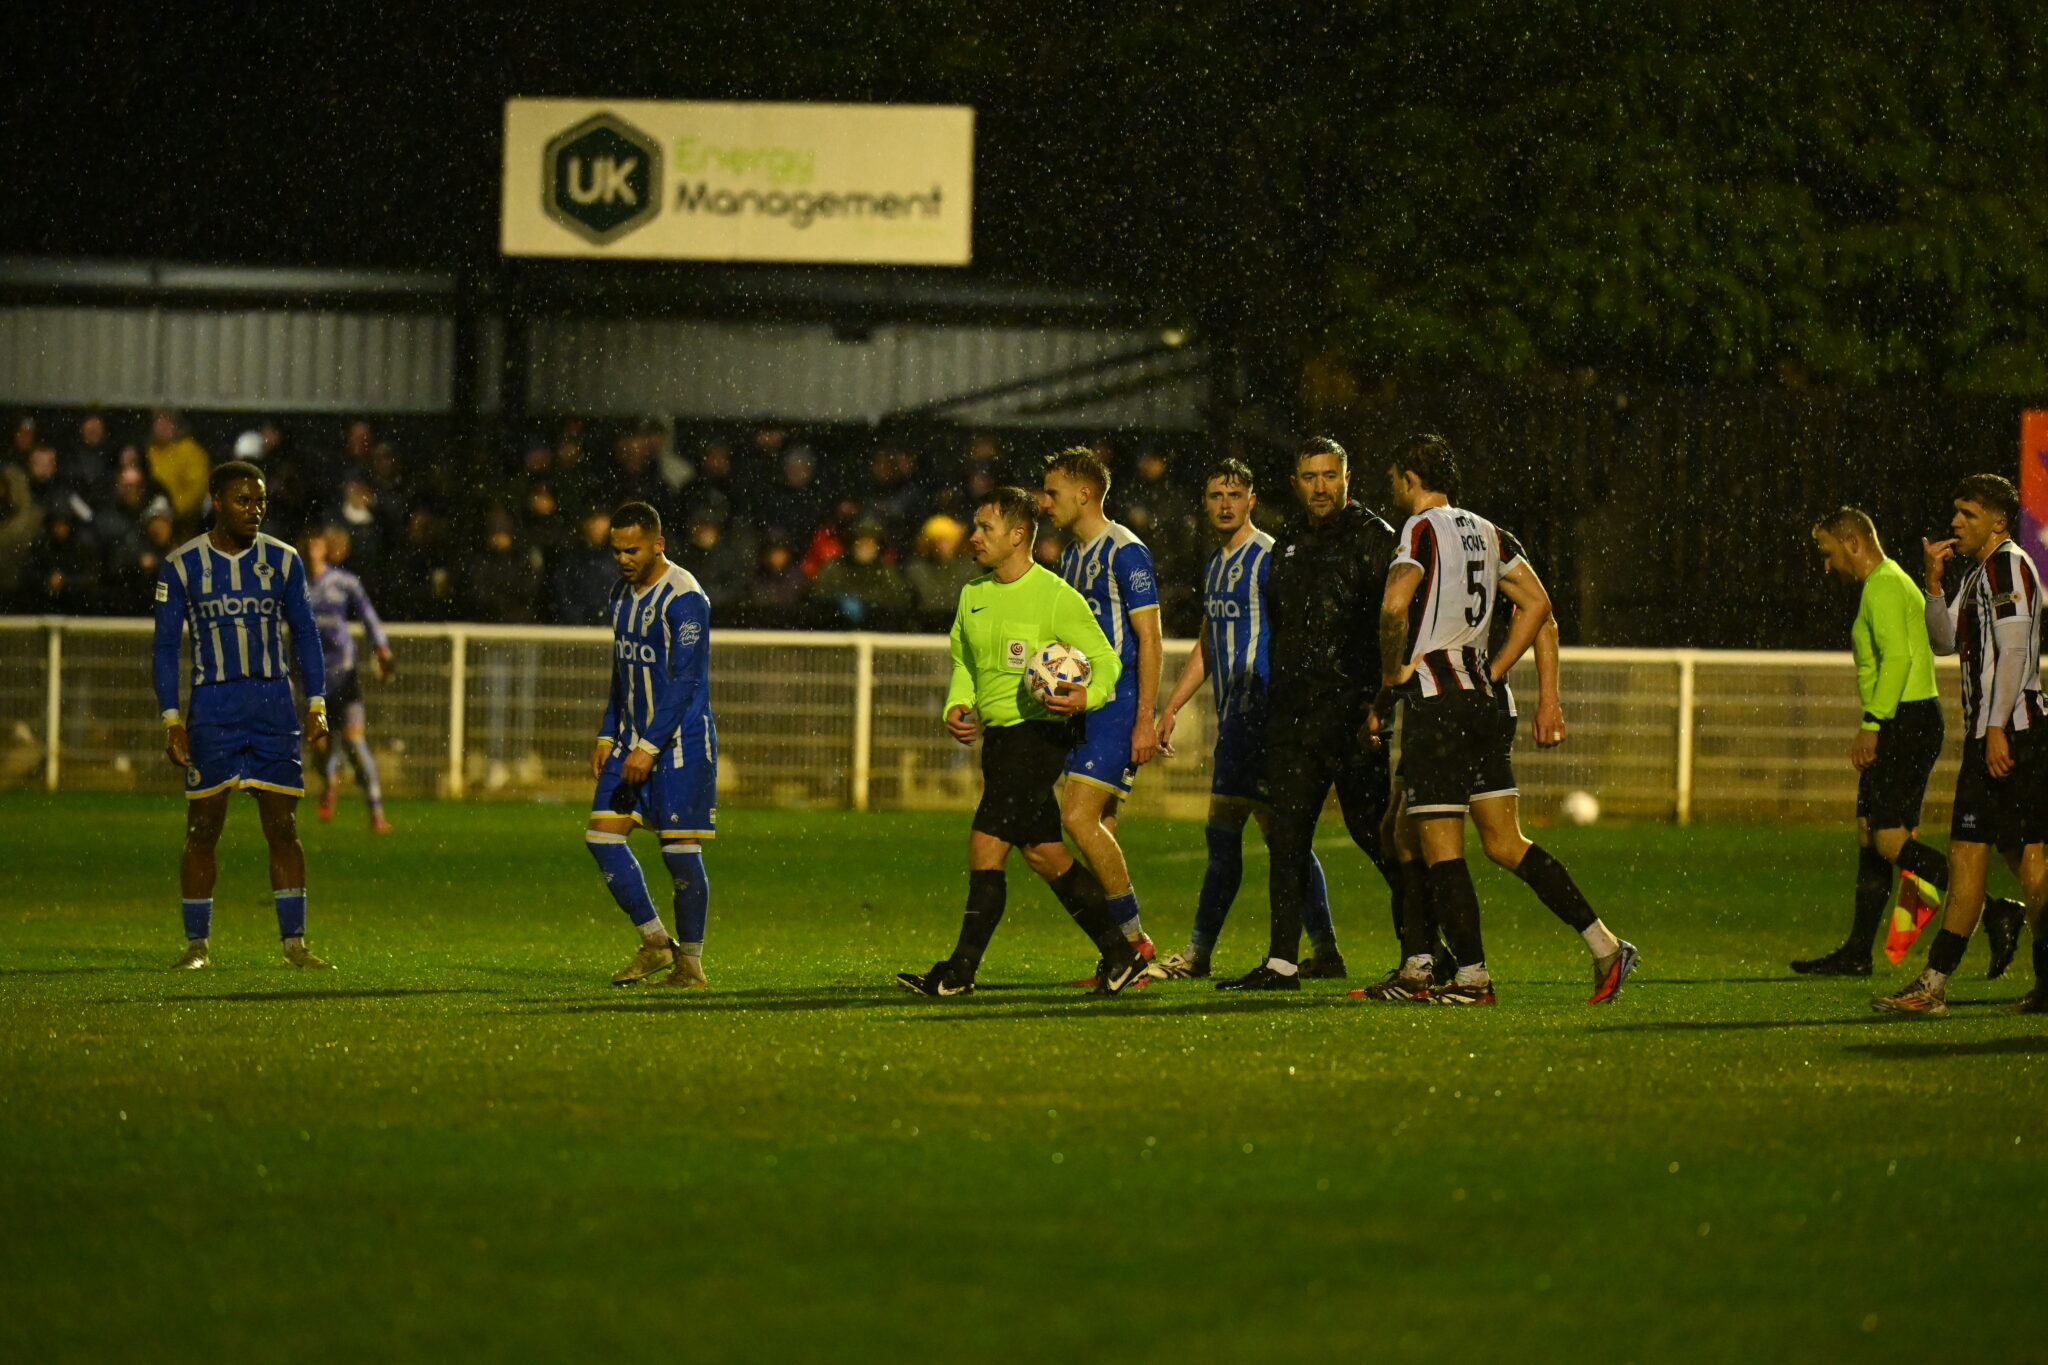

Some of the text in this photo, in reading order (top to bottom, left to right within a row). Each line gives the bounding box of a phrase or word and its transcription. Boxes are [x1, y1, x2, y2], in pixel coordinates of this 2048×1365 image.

[567, 155, 638, 206] UK
[674, 138, 816, 185] Energy
[674, 180, 942, 230] Management
[200, 593, 275, 619] mbna
[1204, 594, 1240, 618] bna
[1465, 560, 1487, 627] 5
